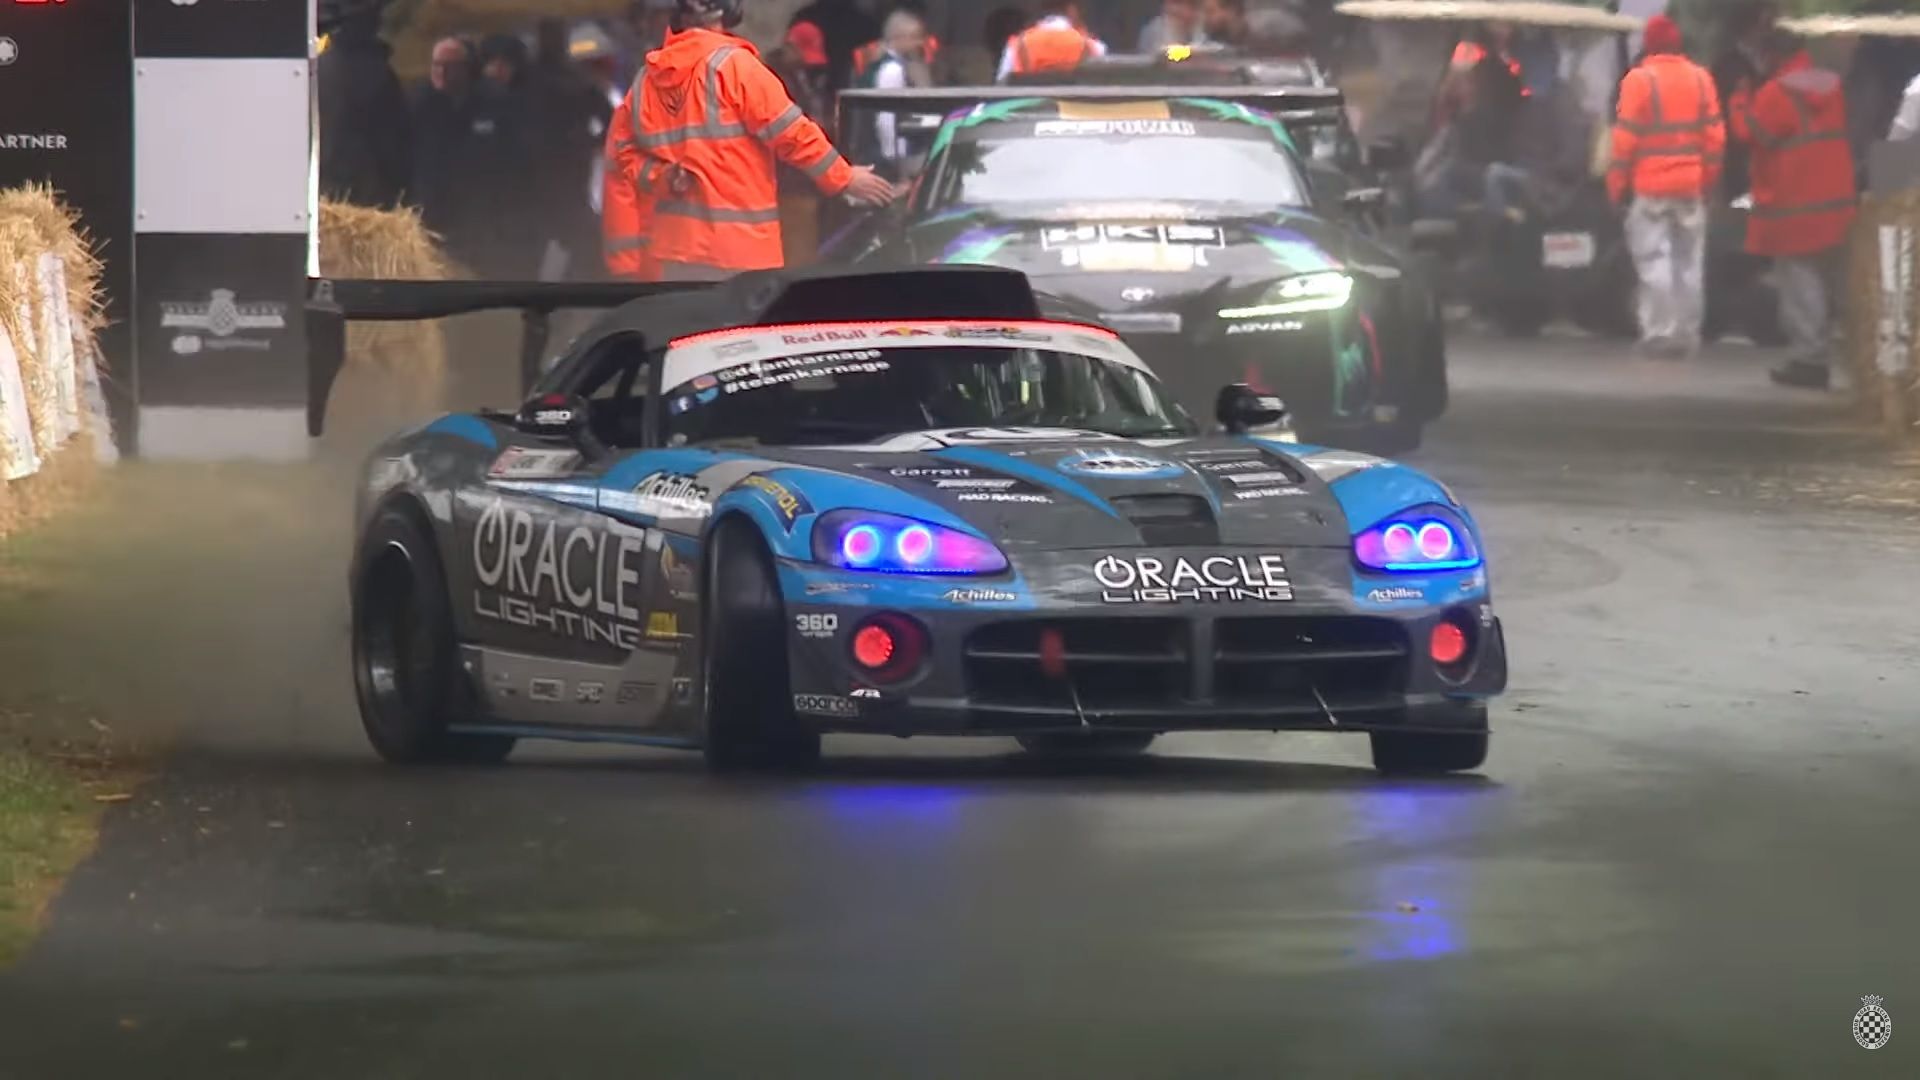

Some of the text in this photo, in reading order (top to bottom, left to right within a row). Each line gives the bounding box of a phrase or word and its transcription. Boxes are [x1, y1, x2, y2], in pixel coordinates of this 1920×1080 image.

[724, 360, 891, 395] #teamkarnage
[889, 467, 971, 477] Garrett
[473, 497, 643, 621] ORACLE
[1093, 554, 1290, 589] ORACLE
[943, 587, 1016, 604] Achilles
[1102, 585, 1294, 603] LIGHTING
[1367, 588, 1423, 602] Achilles
[474, 588, 641, 650] LIGHTING
[796, 613, 838, 631] 360
